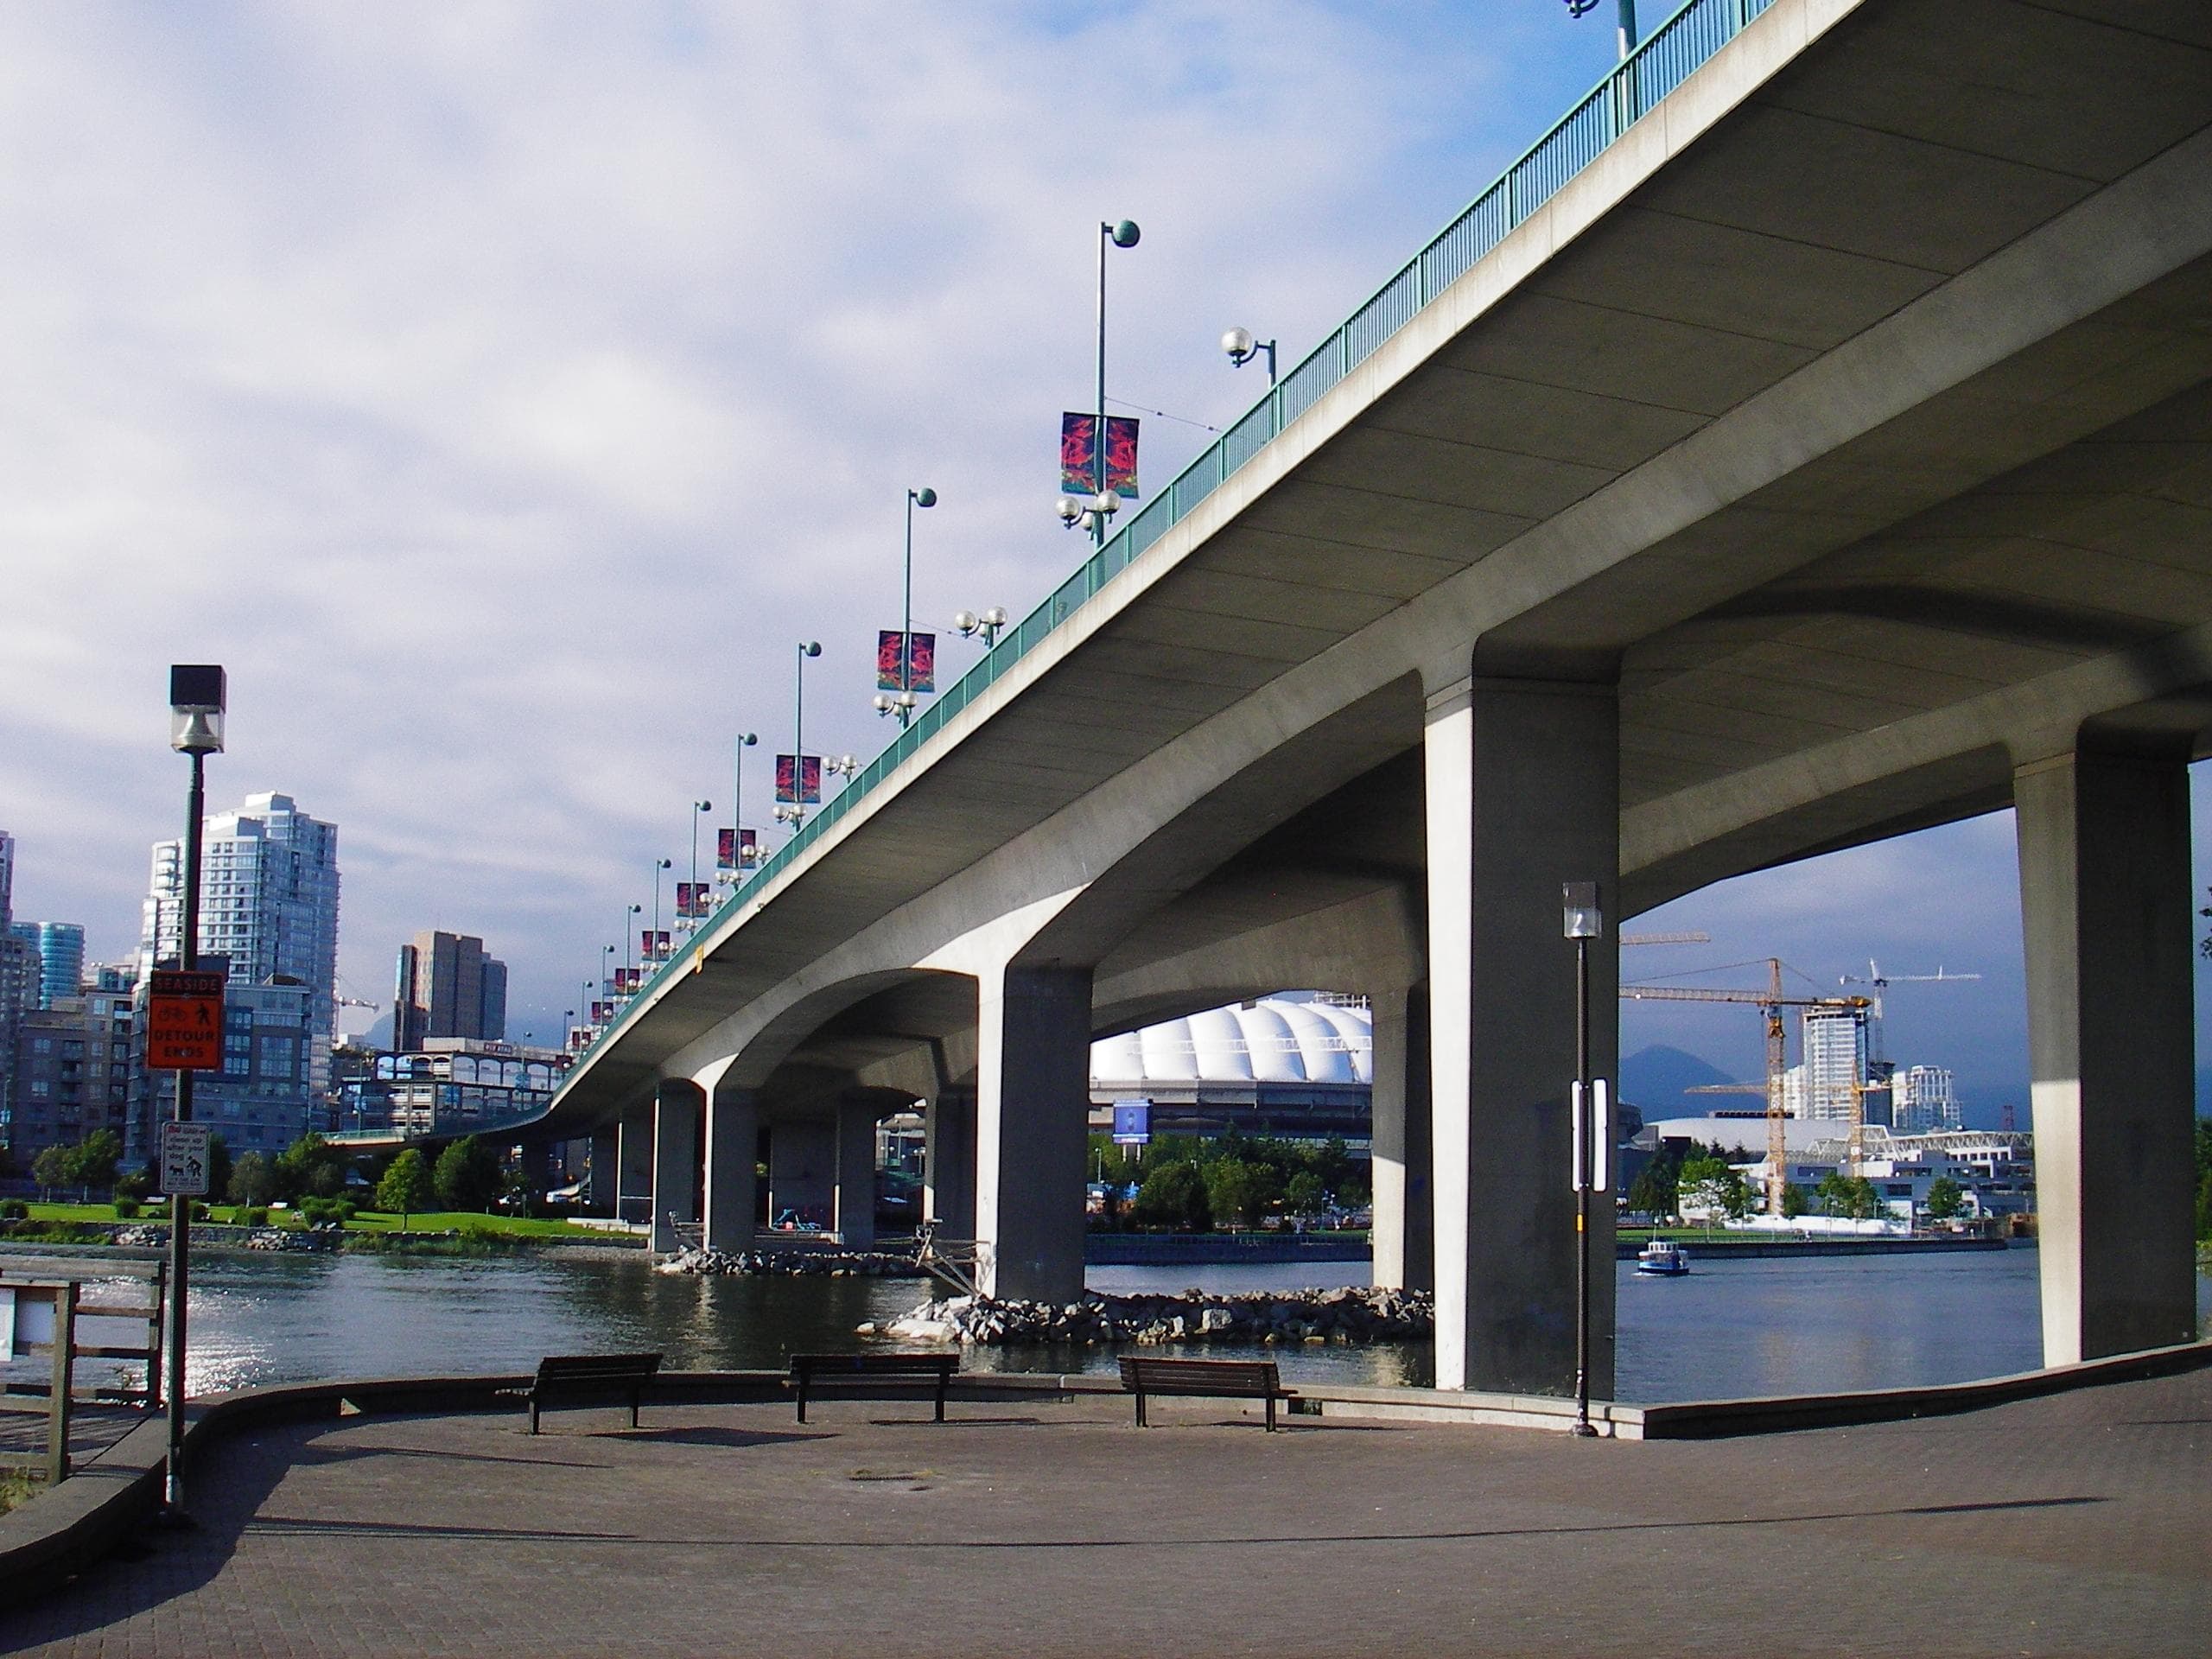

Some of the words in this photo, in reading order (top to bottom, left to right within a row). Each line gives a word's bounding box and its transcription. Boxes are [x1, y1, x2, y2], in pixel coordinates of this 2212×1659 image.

[155, 977, 218, 991] SEASIDE
[154, 1029, 214, 1041] DETOUR
[163, 1046, 204, 1058] ENDS
